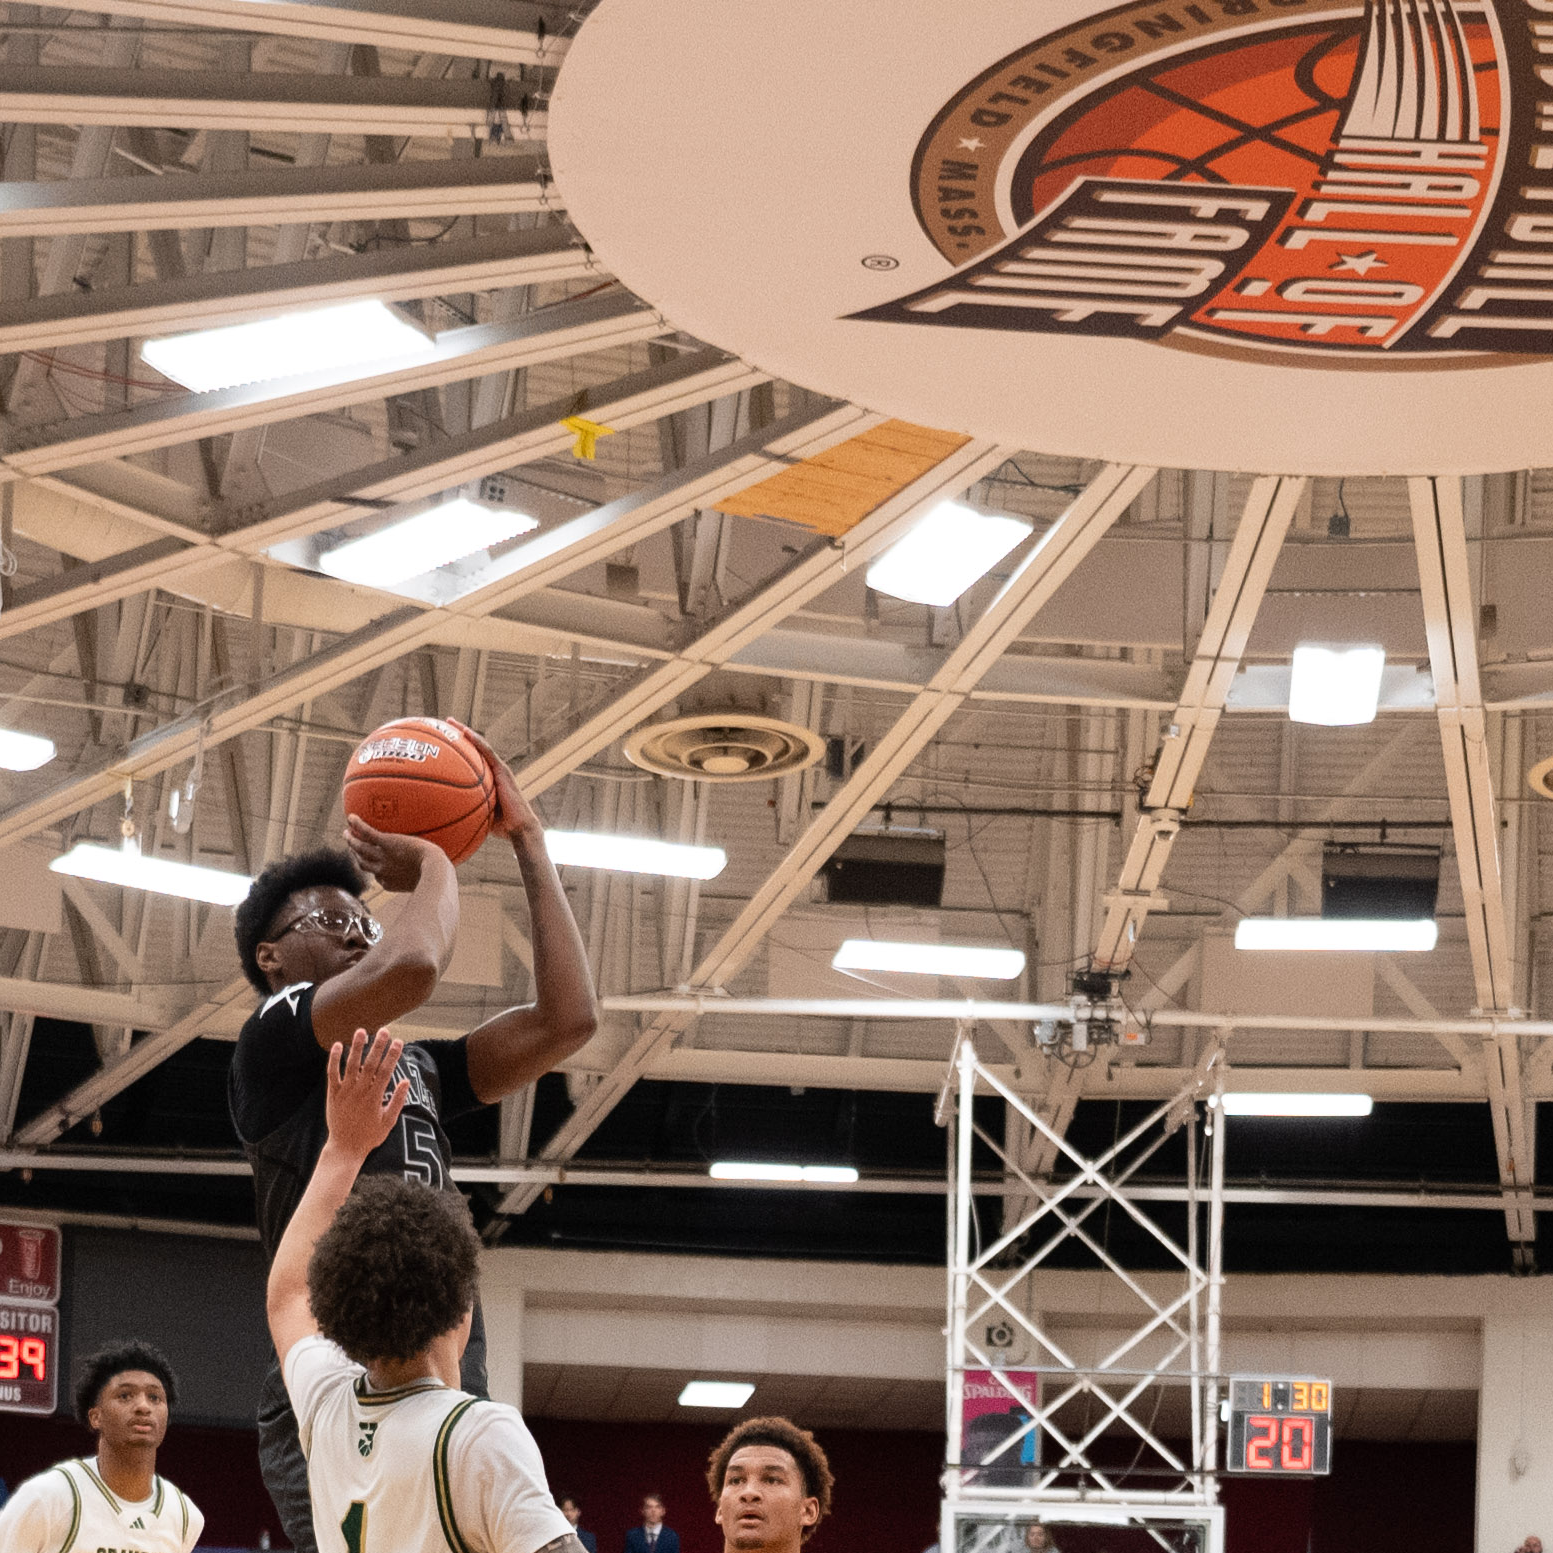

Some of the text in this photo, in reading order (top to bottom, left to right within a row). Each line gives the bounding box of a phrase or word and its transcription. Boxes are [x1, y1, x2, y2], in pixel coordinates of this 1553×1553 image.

[1279, 138, 1489, 250] HALL
[904, 190, 1271, 326] FAME
[8, 1278, 52, 1298] Enjoy
[1247, 1416, 1312, 1470] 20
